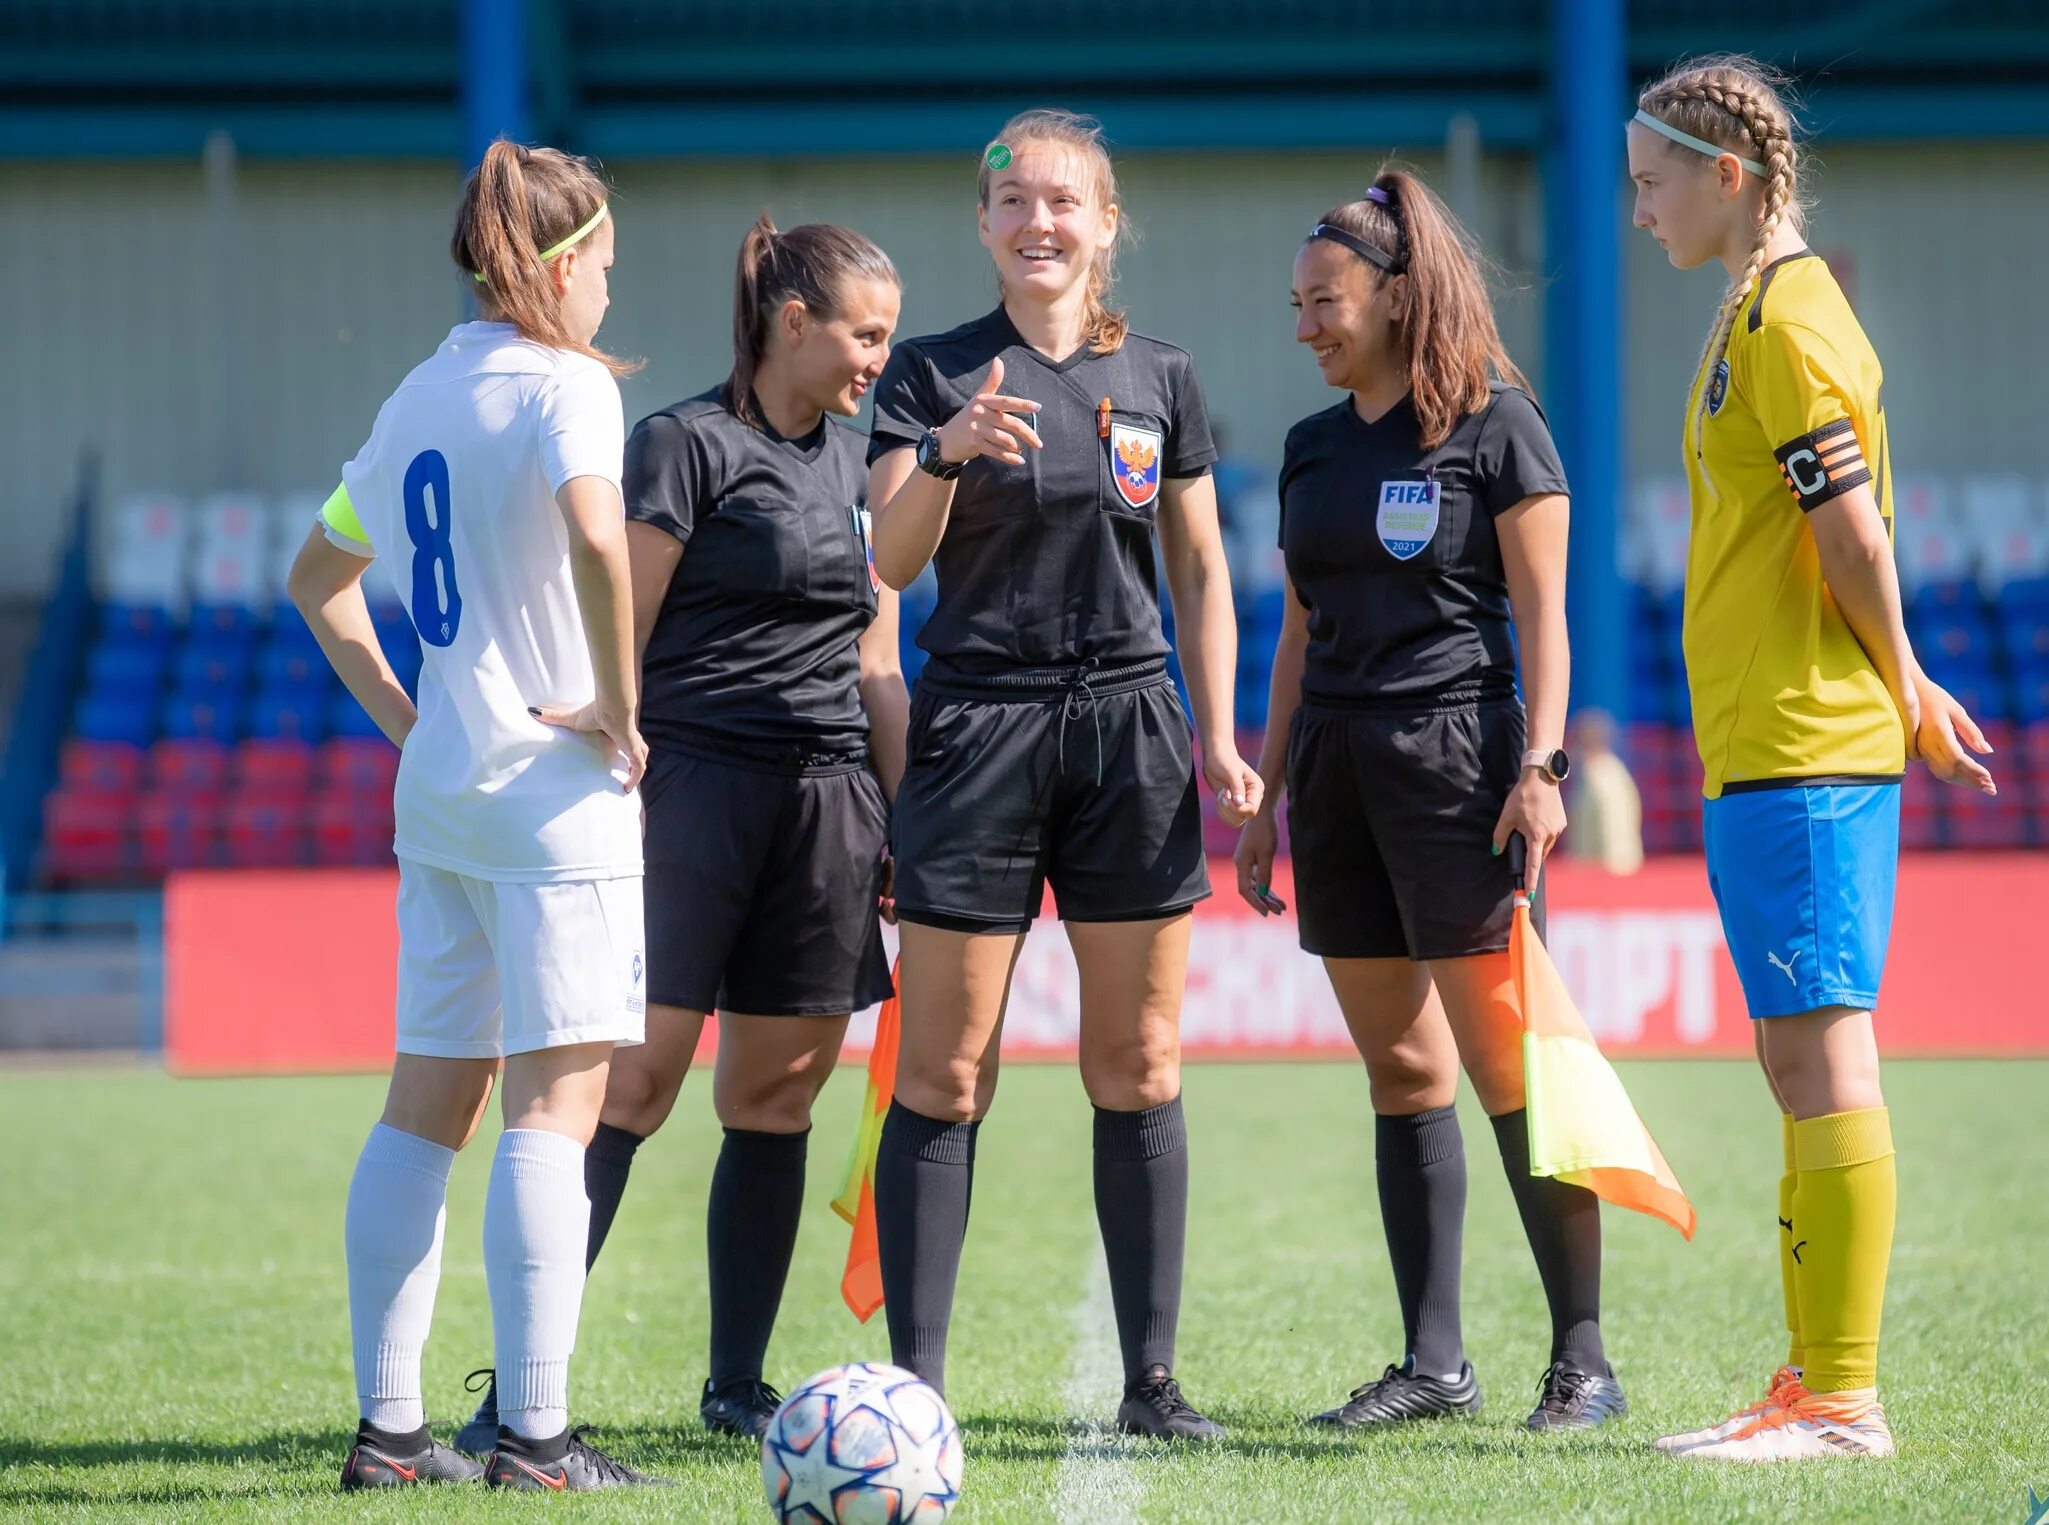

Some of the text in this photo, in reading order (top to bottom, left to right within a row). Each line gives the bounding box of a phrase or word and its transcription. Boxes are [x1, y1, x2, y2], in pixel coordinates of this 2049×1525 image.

[1786, 448, 1827, 496] C
[1385, 486, 1433, 504] FIFA
[404, 449, 463, 648] 8
[1392, 541, 1415, 552] 2021
